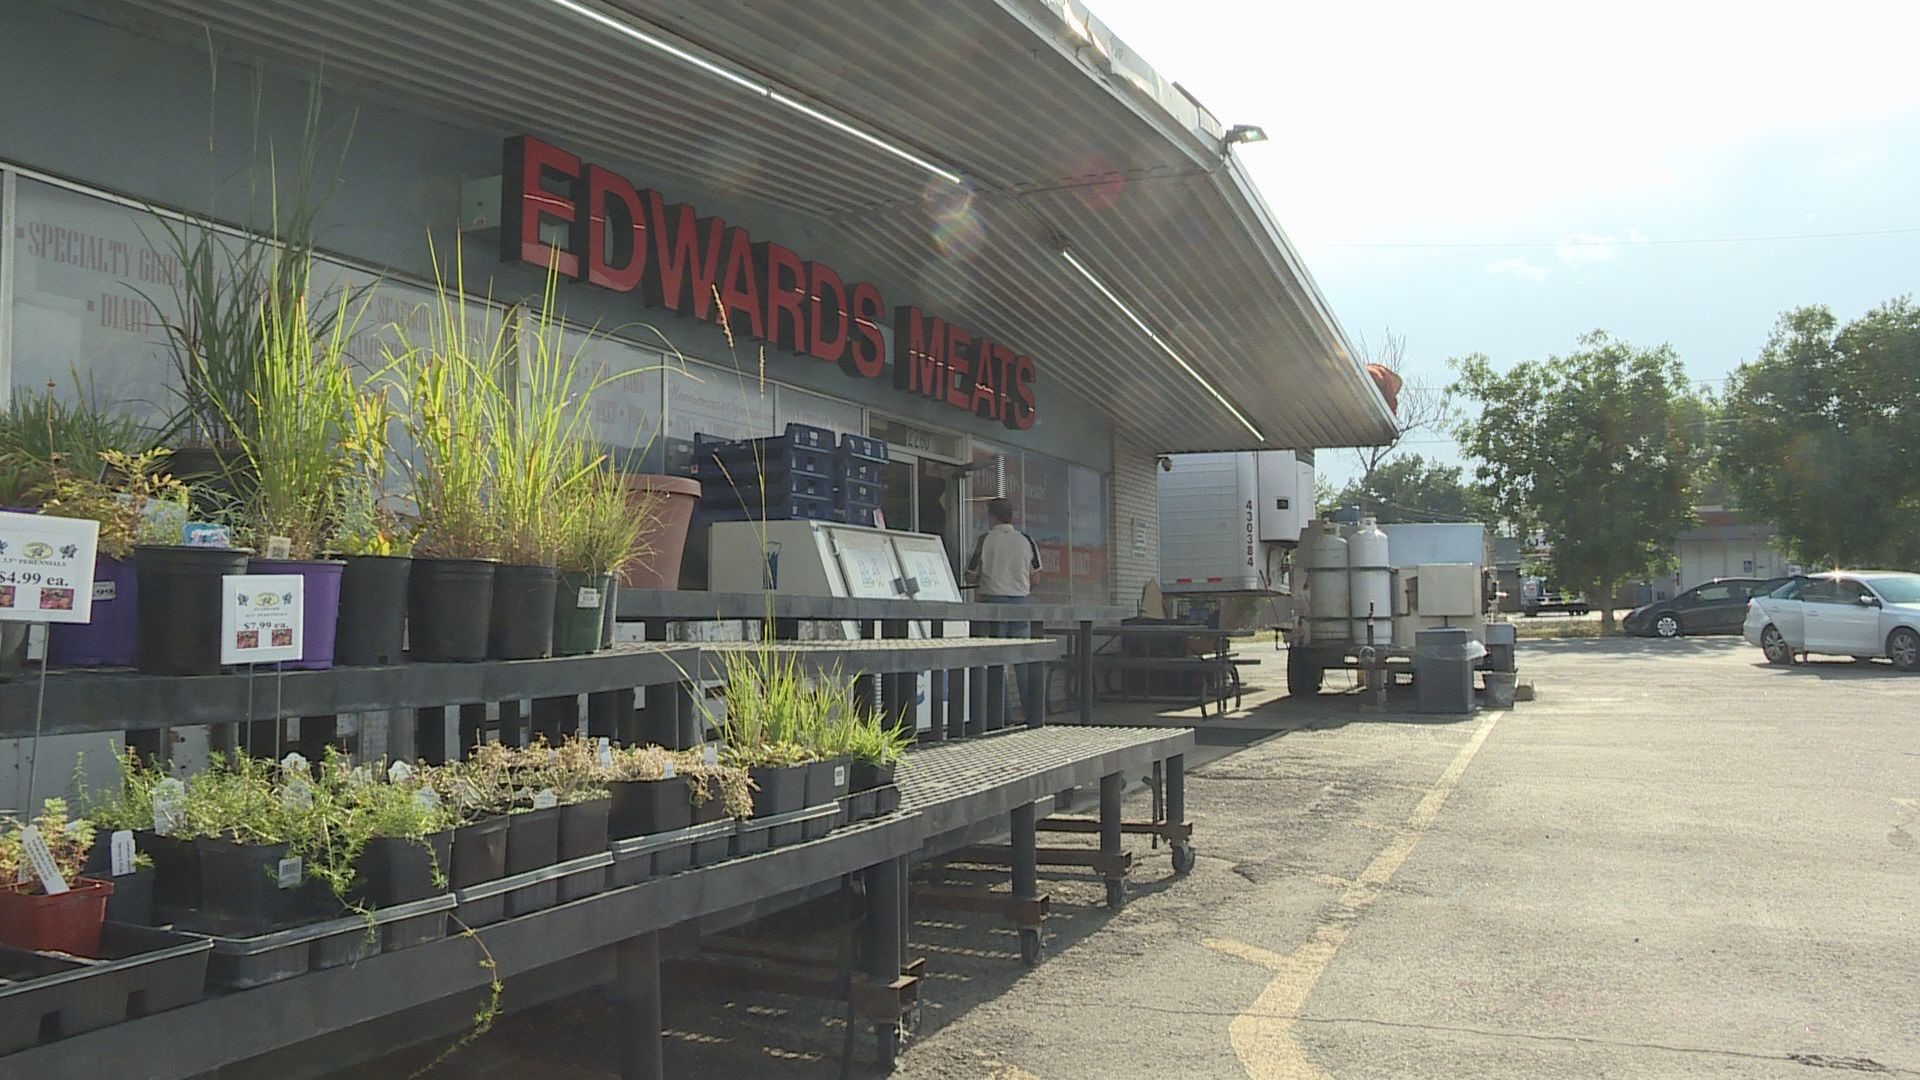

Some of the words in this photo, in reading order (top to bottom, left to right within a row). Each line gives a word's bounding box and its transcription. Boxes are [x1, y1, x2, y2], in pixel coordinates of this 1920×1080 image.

[27, 220, 132, 278] SPECIALTY
[520, 134, 886, 379] EDWARDS
[908, 305, 1037, 431] MEATS
[19, 559, 67, 567] PERENNIALS
[0, 571, 42, 585] $4.99
[46, 576, 69, 587] ea.
[243, 621, 272, 630] $7.99
